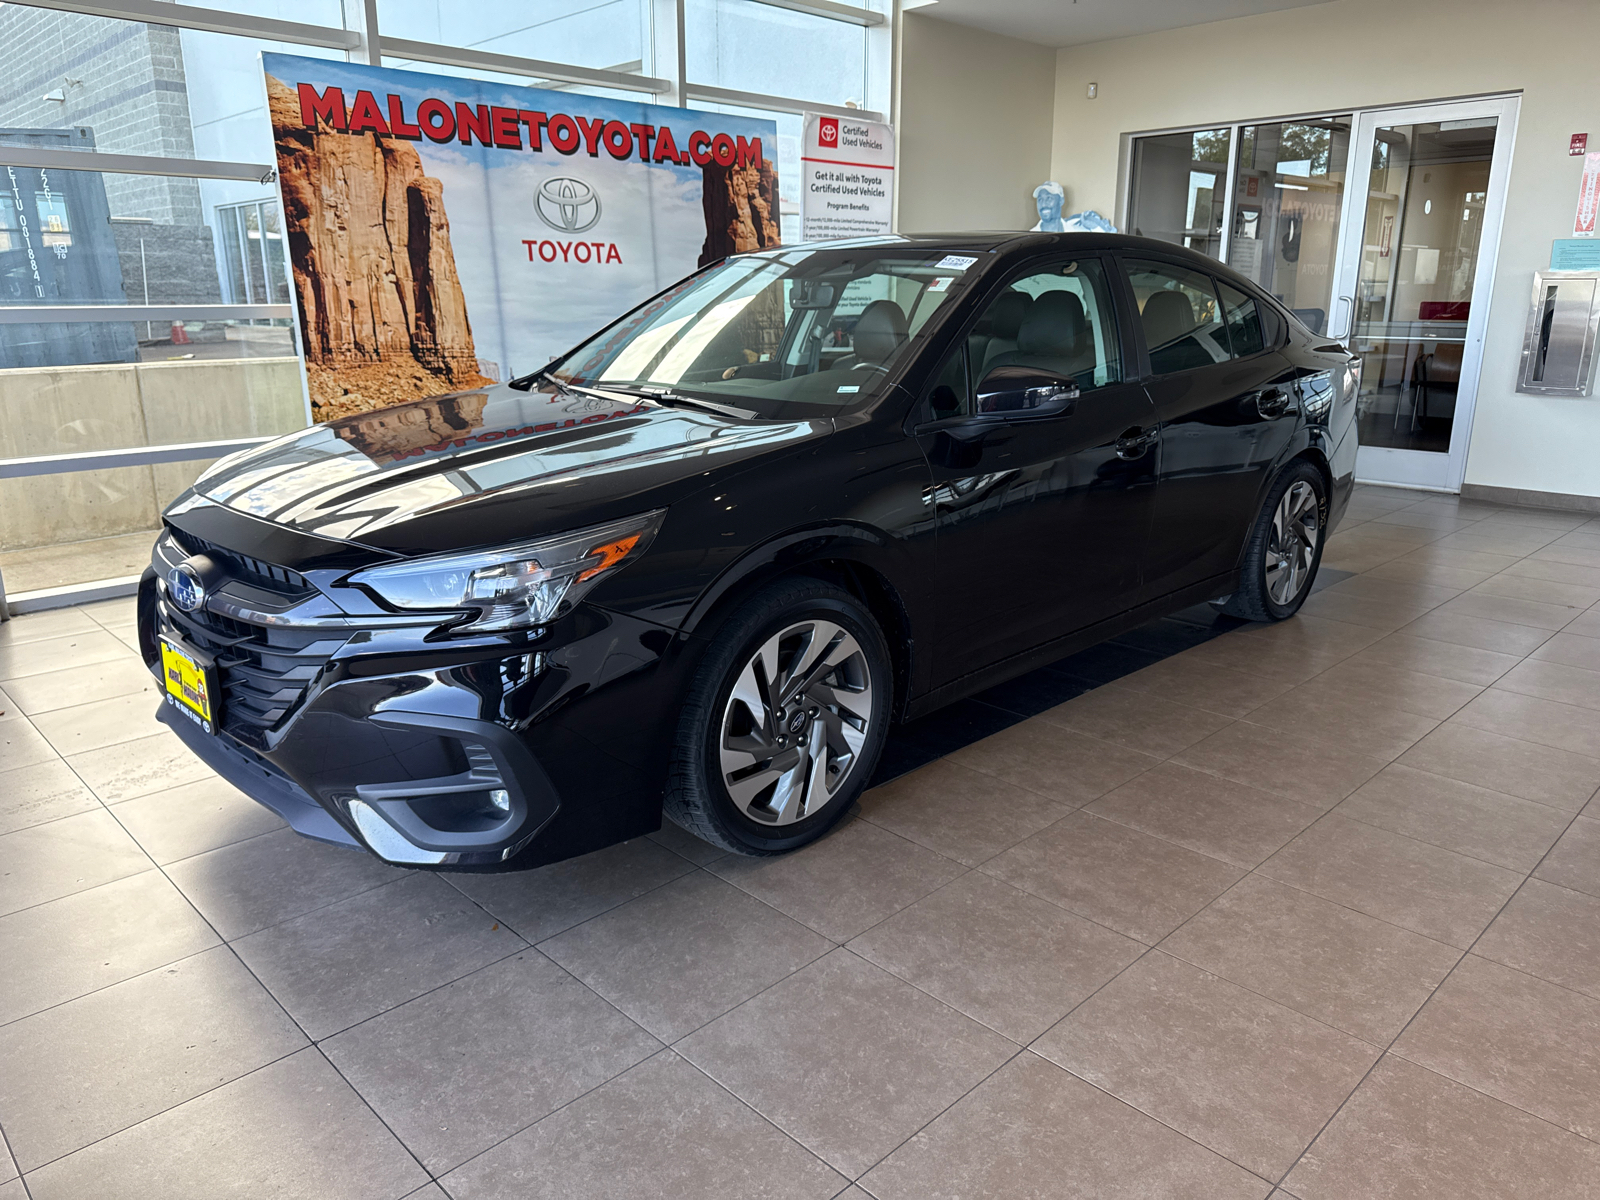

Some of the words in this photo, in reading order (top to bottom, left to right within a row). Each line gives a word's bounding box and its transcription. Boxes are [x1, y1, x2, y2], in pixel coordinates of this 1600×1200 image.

[297, 82, 763, 171] MALONETOYOTA.COM
[842, 125, 869, 137] Certified
[842, 136, 858, 147] Used
[858, 138, 883, 150] Vehicles
[815, 170, 828, 181] Get
[829, 171, 834, 181] it
[835, 172, 845, 182] all
[845, 173, 860, 183] with
[861, 175, 882, 186] Toyota
[810, 183, 840, 194] Certified
[841, 185, 859, 195] Used
[859, 186, 885, 197] Vehicles
[827, 201, 849, 211] Program
[849, 203, 870, 211] Benefits
[20, 214, 41, 282] 081884
[521, 239, 623, 264] TOYOTA
